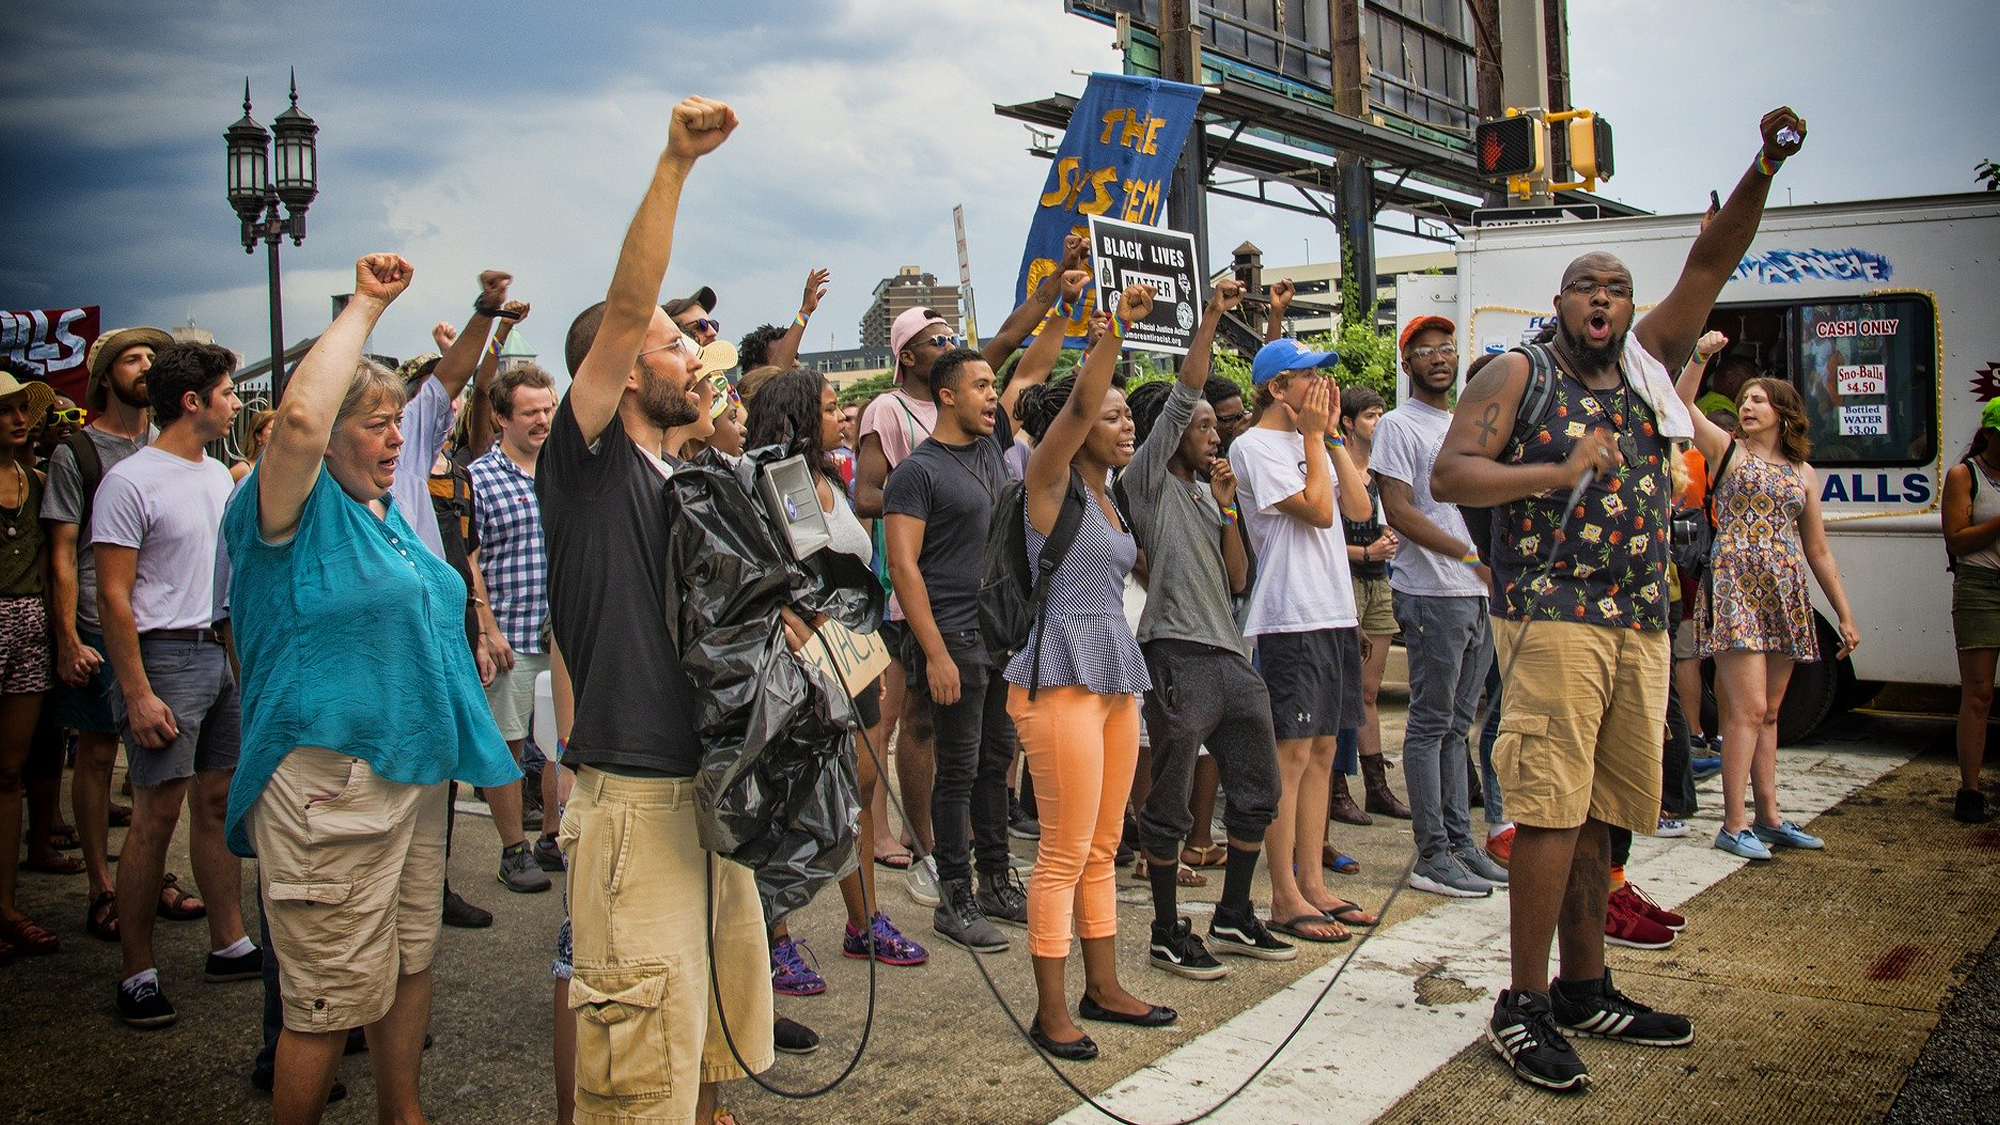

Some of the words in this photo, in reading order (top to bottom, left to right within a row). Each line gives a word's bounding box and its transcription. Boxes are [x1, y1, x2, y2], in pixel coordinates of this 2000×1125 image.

[1100, 108, 1167, 155] THE
[1103, 236, 1144, 261] BLACK
[1150, 245, 1185, 268] LIVES
[1139, 322, 1155, 332] Racial
[1155, 325, 1174, 335] Justice
[1174, 327, 1190, 336] Action
[1816, 321, 1857, 338] CASH
[1859, 319, 1899, 336] ONLY
[1839, 365, 1884, 382] Sno-Balls
[1847, 382, 1876, 393] $4.50
[1845, 405, 1880, 414] Bottled
[1844, 415, 1882, 424] WATER
[1848, 426, 1877, 435] $3.00
